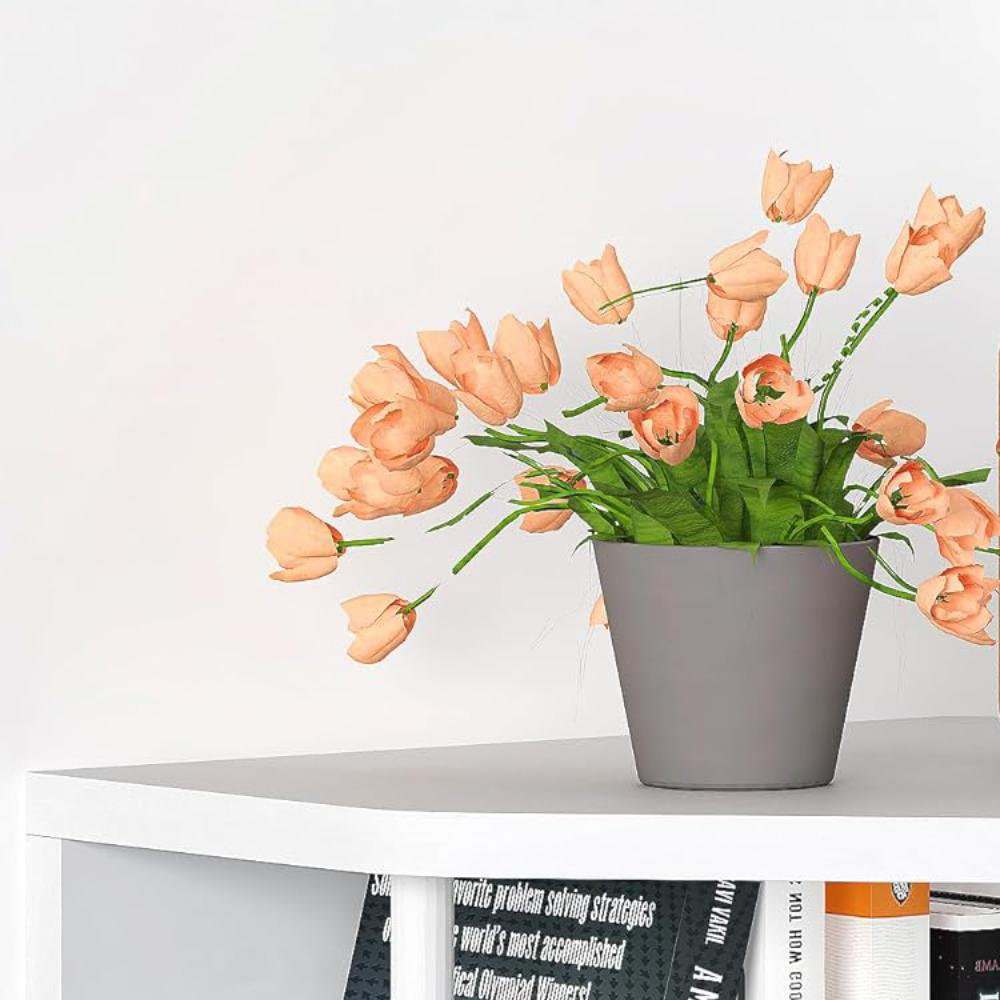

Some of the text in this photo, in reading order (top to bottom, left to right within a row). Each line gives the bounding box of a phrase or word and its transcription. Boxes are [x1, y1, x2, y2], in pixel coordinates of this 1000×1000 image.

[371, 873, 392, 897] So
[492, 882, 545, 915] problem
[545, 884, 592, 924] solving
[590, 892, 657, 931] strategies
[704, 880, 736, 945] AVI VAKIL
[458, 924, 507, 957] world's
[506, 929, 541, 960] most
[540, 932, 627, 970] accomplished
[692, 964, 724, 984] A
